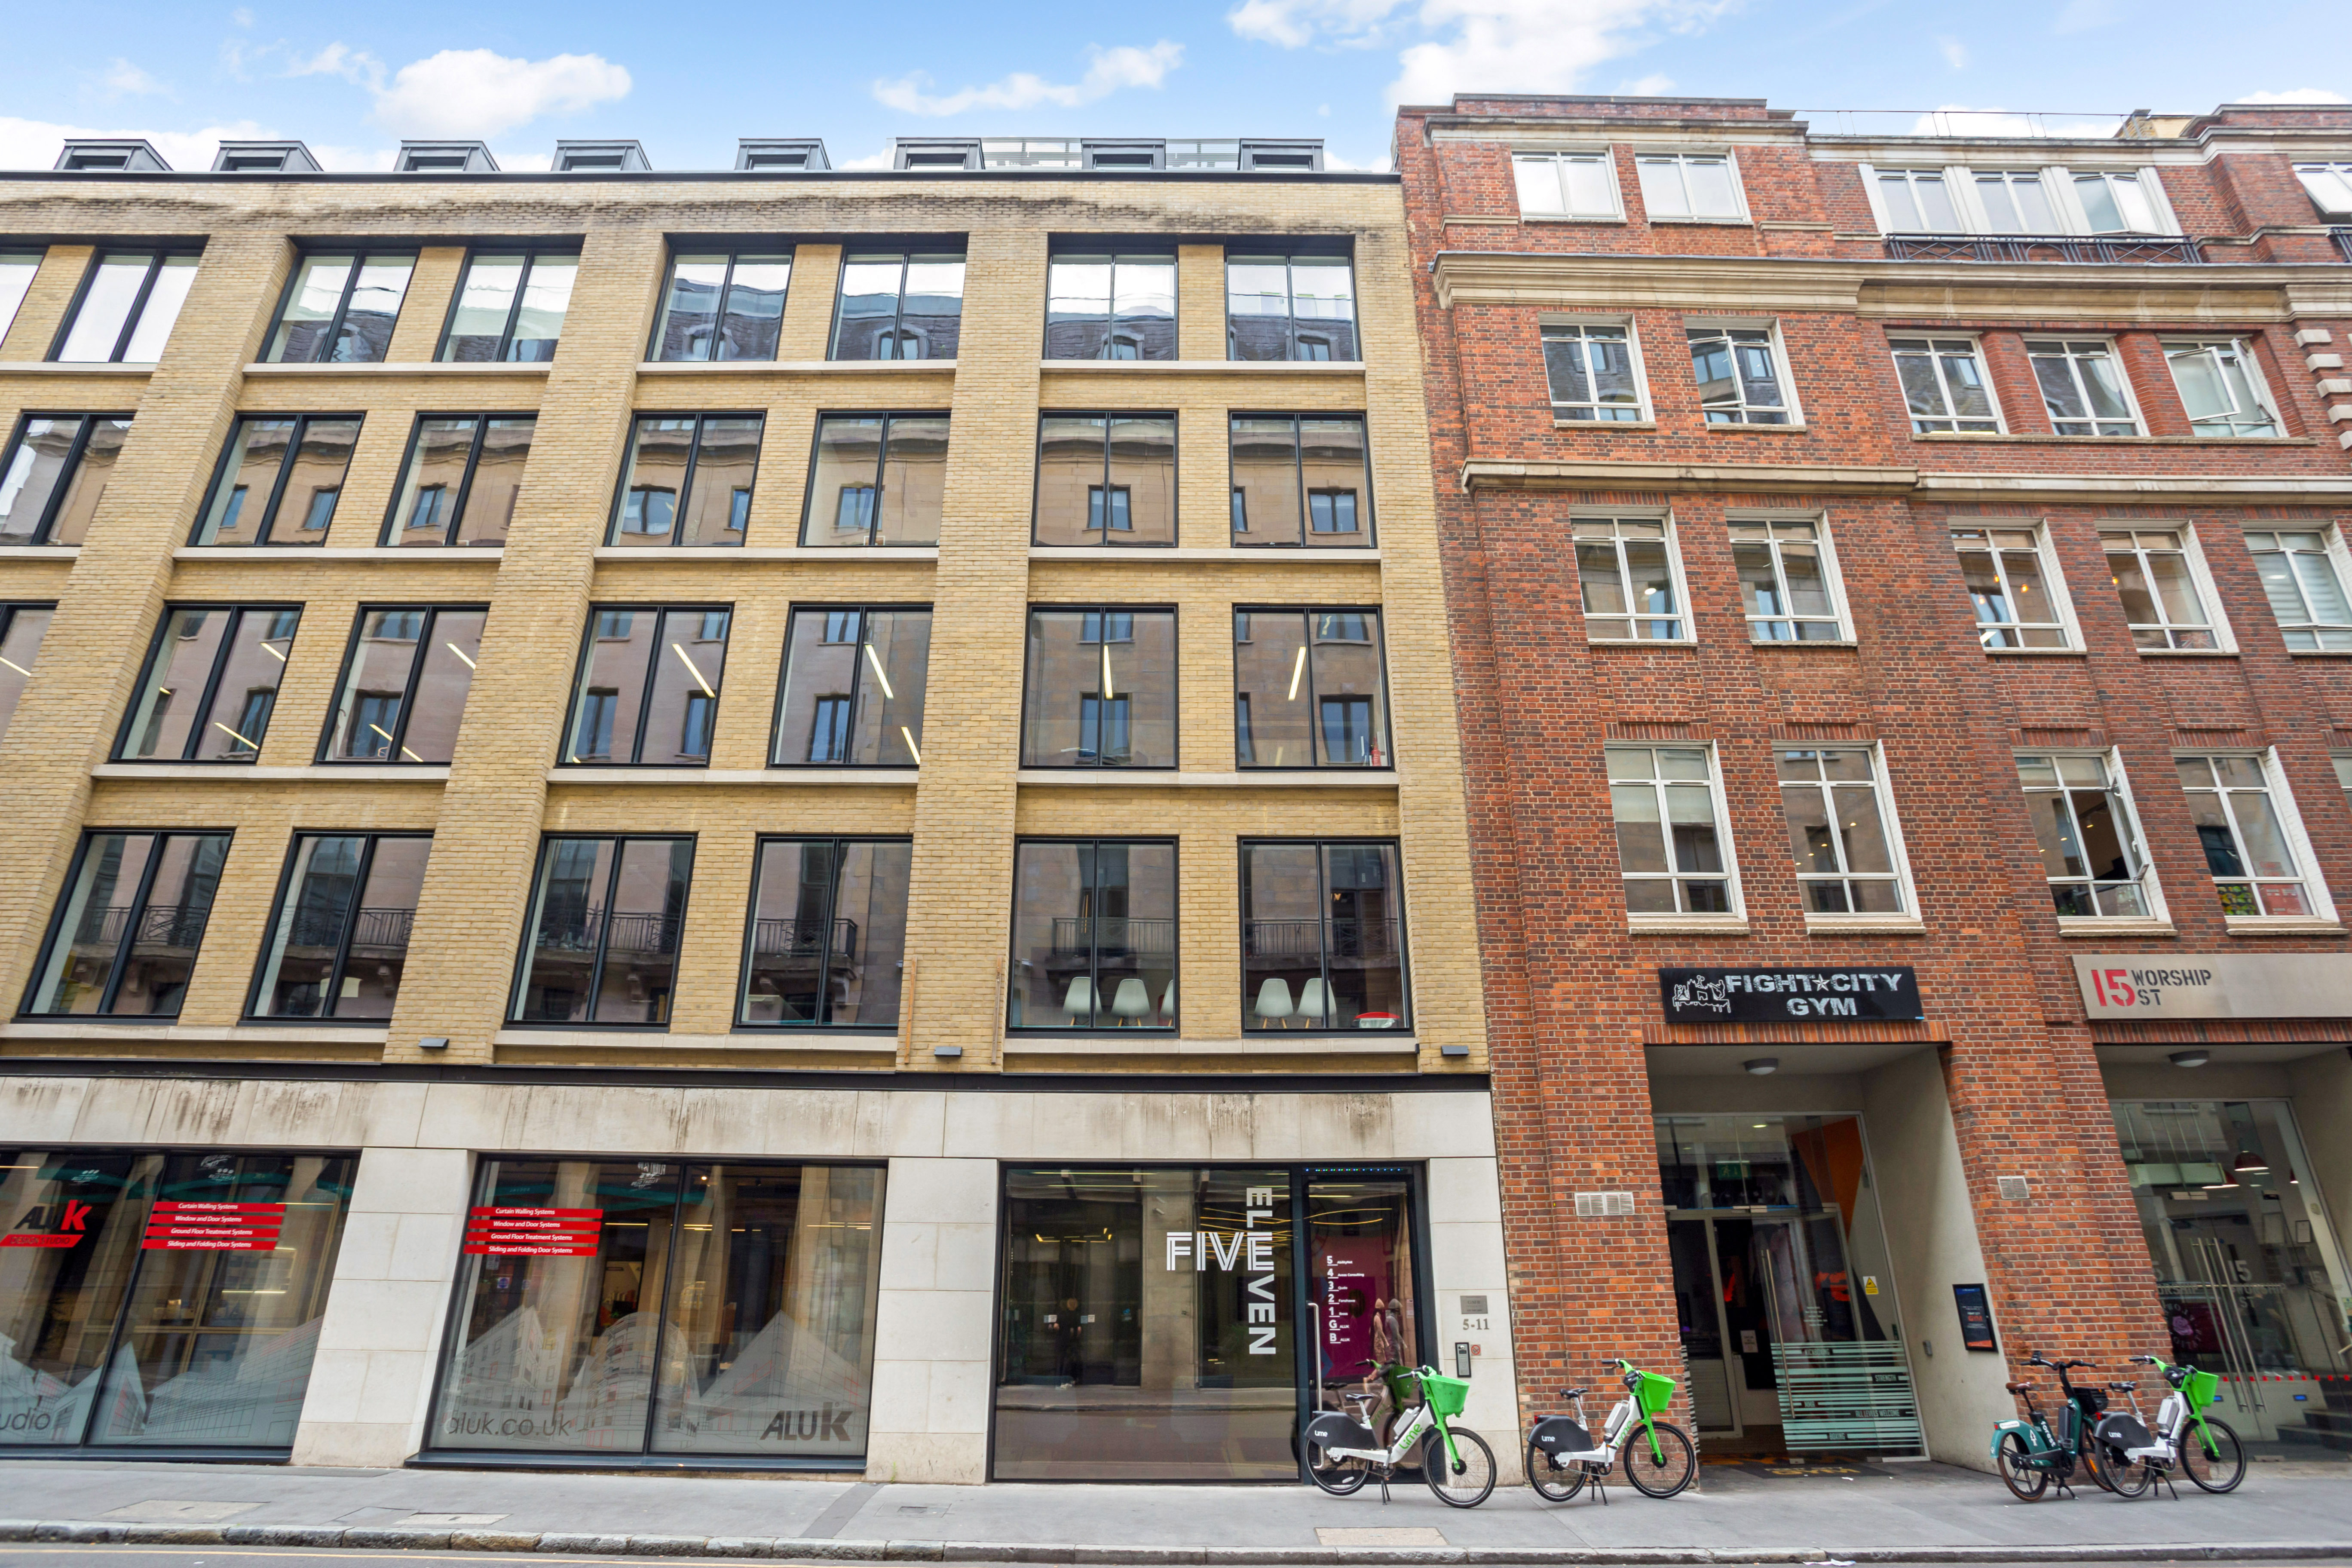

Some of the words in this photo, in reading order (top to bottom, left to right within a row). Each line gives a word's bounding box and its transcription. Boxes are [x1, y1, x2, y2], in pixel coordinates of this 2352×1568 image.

[1724, 974, 1815, 992] FIGHT
[1829, 973, 1902, 992] CITY
[2131, 969, 2211, 986] WORSHIP
[2091, 969, 2135, 1007] 15
[2137, 989, 2161, 1005] ST
[1786, 997, 1858, 1016] GYM
[1166, 1231, 1274, 1271] FIVE
[1327, 1256, 1333, 1264] 5
[1246, 1187, 1276, 1354] ELEVEN
[1327, 1268, 1334, 1277] 4
[2227, 1259, 2252, 1282] 15
[1328, 1280, 1334, 1290] 3
[1328, 1293, 1334, 1303] 2
[1329, 1307, 1334, 1316] 1
[1329, 1320, 1337, 1329] G
[1463, 1318, 1490, 1331] 5-11
[1329, 1332, 1337, 1342] B
[443, 1412, 571, 1436] aluk.co.uk
